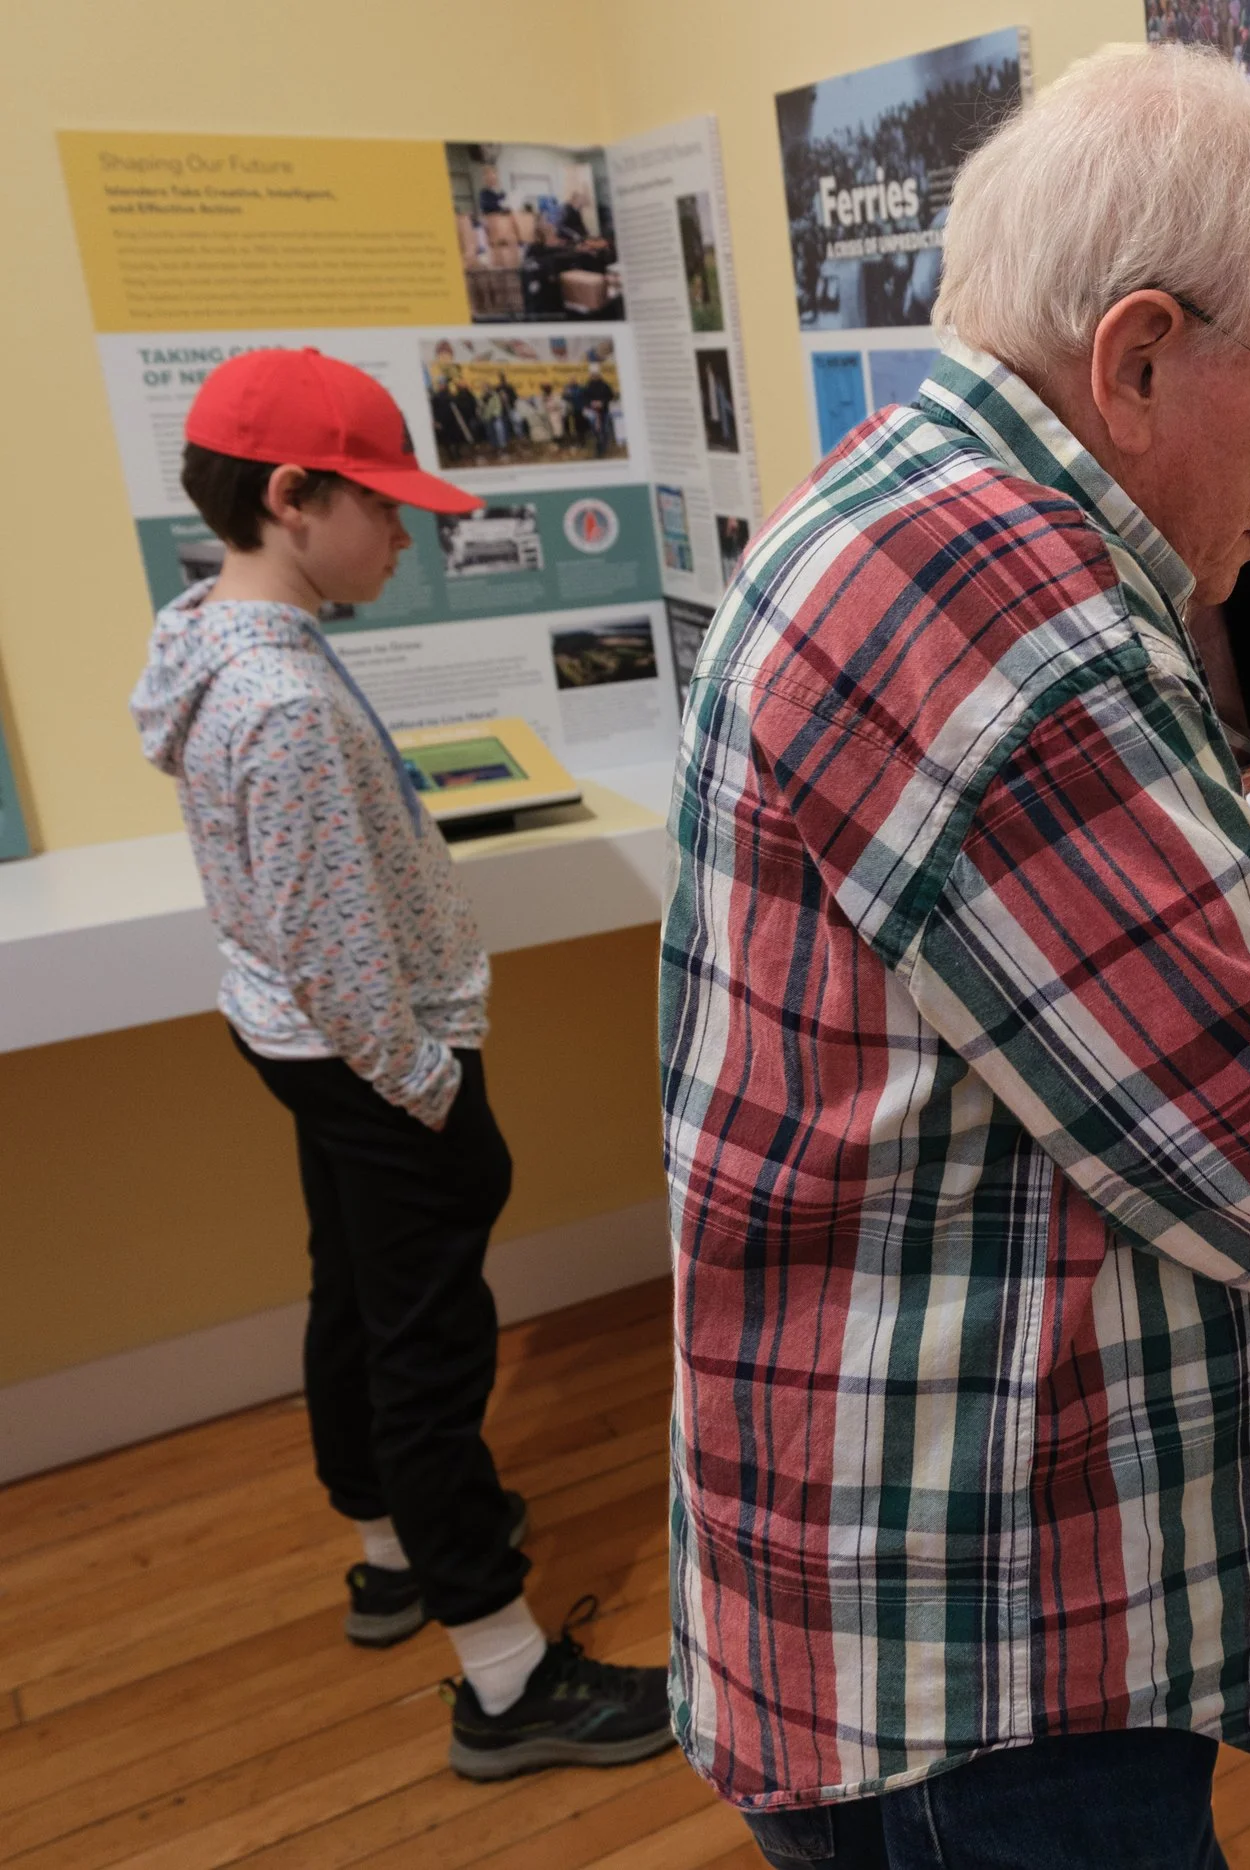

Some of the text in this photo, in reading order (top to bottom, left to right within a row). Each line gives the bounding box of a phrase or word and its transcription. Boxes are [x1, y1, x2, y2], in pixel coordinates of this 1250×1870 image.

[100, 152, 294, 176] Shaping Our Future
[819, 166, 919, 228] Ferries
[137, 346, 223, 364] TAKING
[143, 370, 171, 386] OF
